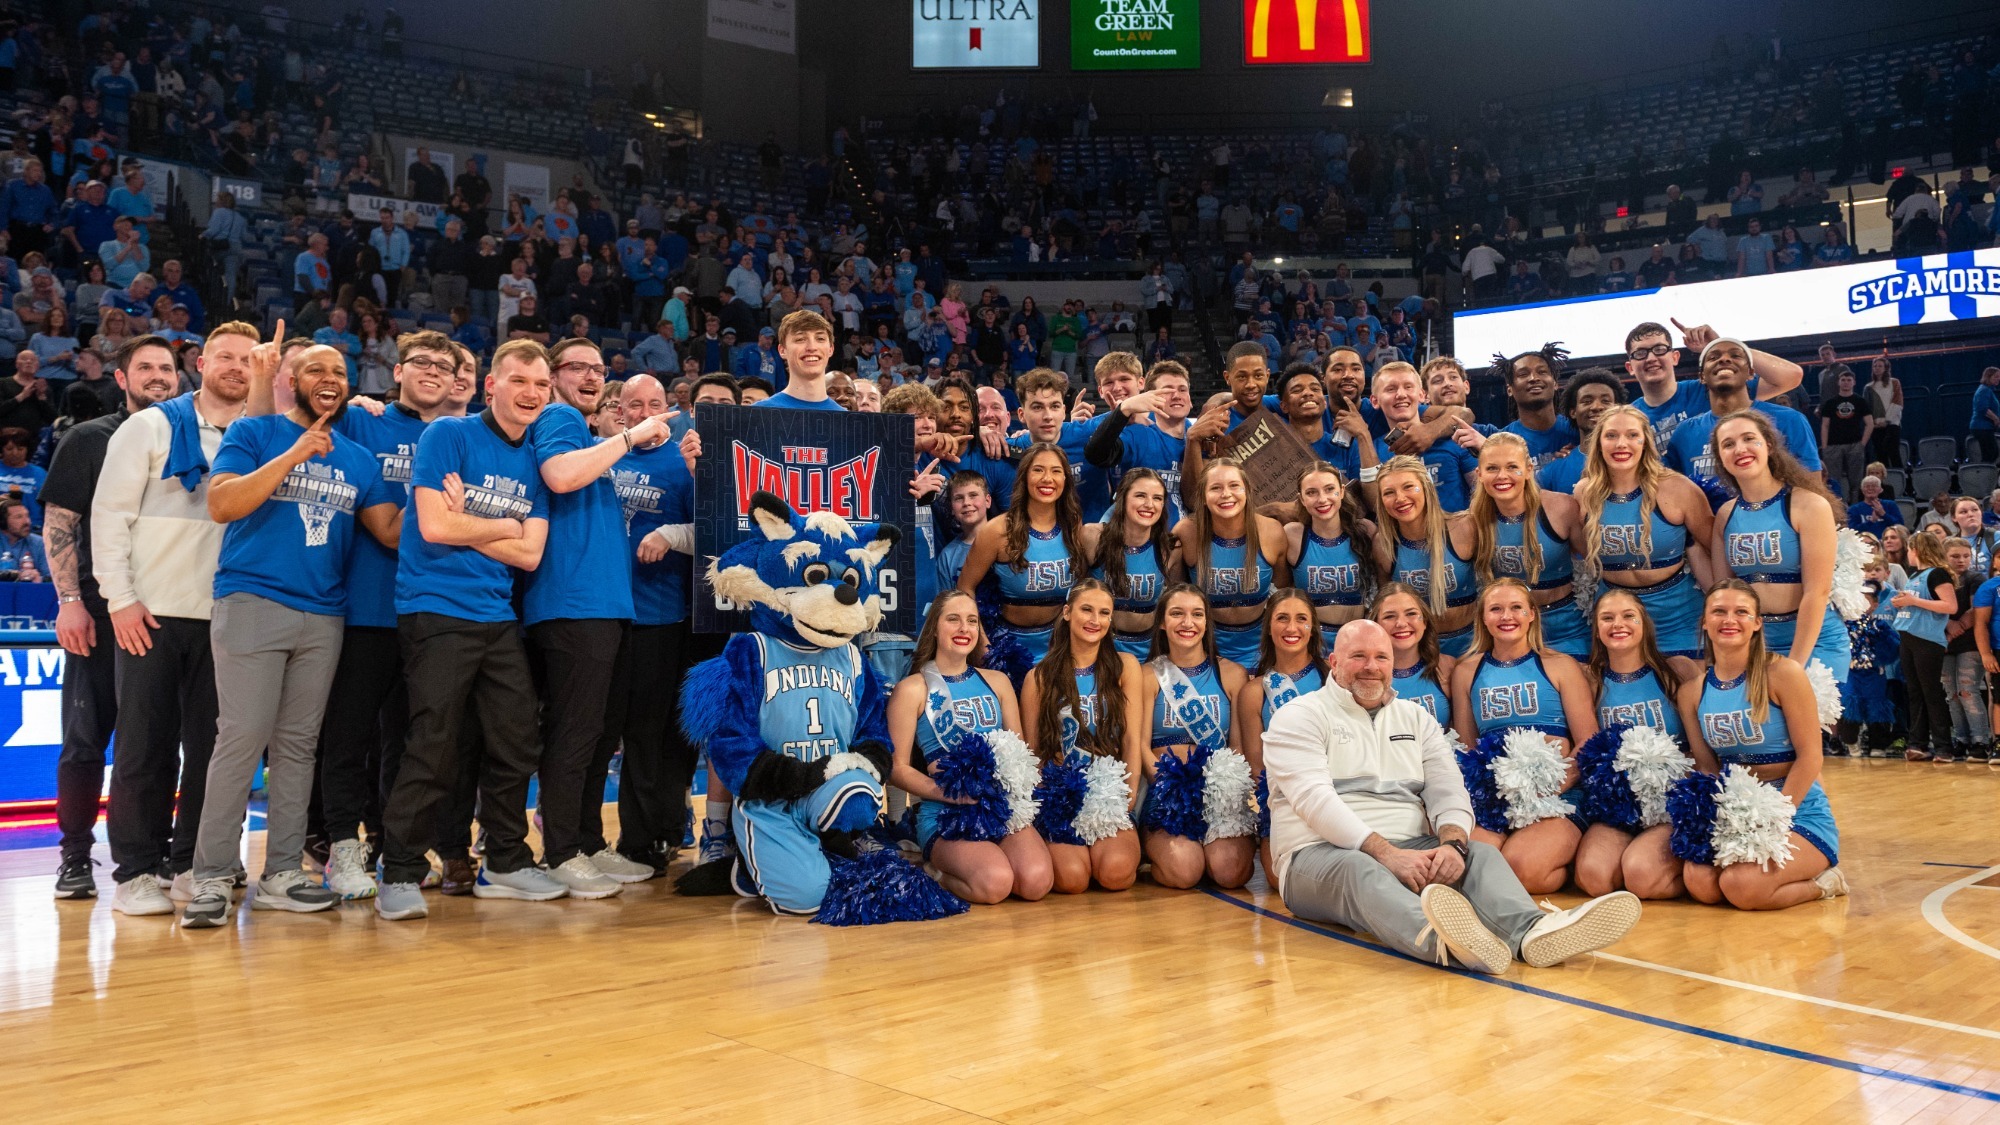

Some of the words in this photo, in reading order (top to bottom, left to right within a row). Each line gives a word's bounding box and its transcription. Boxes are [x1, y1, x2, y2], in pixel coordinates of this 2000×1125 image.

[920, 0, 1033, 20] ULTRA
[1104, 0, 1169, 14] TEAM
[1095, 14, 1175, 31] GREEN
[1116, 31, 1153, 41] LAW
[1093, 48, 1177, 56] CountOnGreen.com
[1852, 268, 2000, 311] SYCAMORE
[397, 444, 409, 455] 23
[782, 446, 828, 464] THE
[334, 468, 345, 481] 24
[1261, 456, 1277, 471] 2024
[1272, 451, 1304, 480] Basketball
[276, 476, 357, 509] CHAMPIONS
[483, 474, 494, 488] 23
[517, 483, 527, 497] 24
[639, 474, 650, 485] 24
[732, 440, 880, 520] VALLEY
[1728, 530, 1782, 566] ISU
[1307, 563, 1360, 594] ISU
[952, 695, 998, 729] SU
[1480, 681, 1539, 721] ISU
[806, 697, 823, 735] 1
[1601, 699, 1665, 734] ISU
[1704, 708, 1765, 748] ISU
